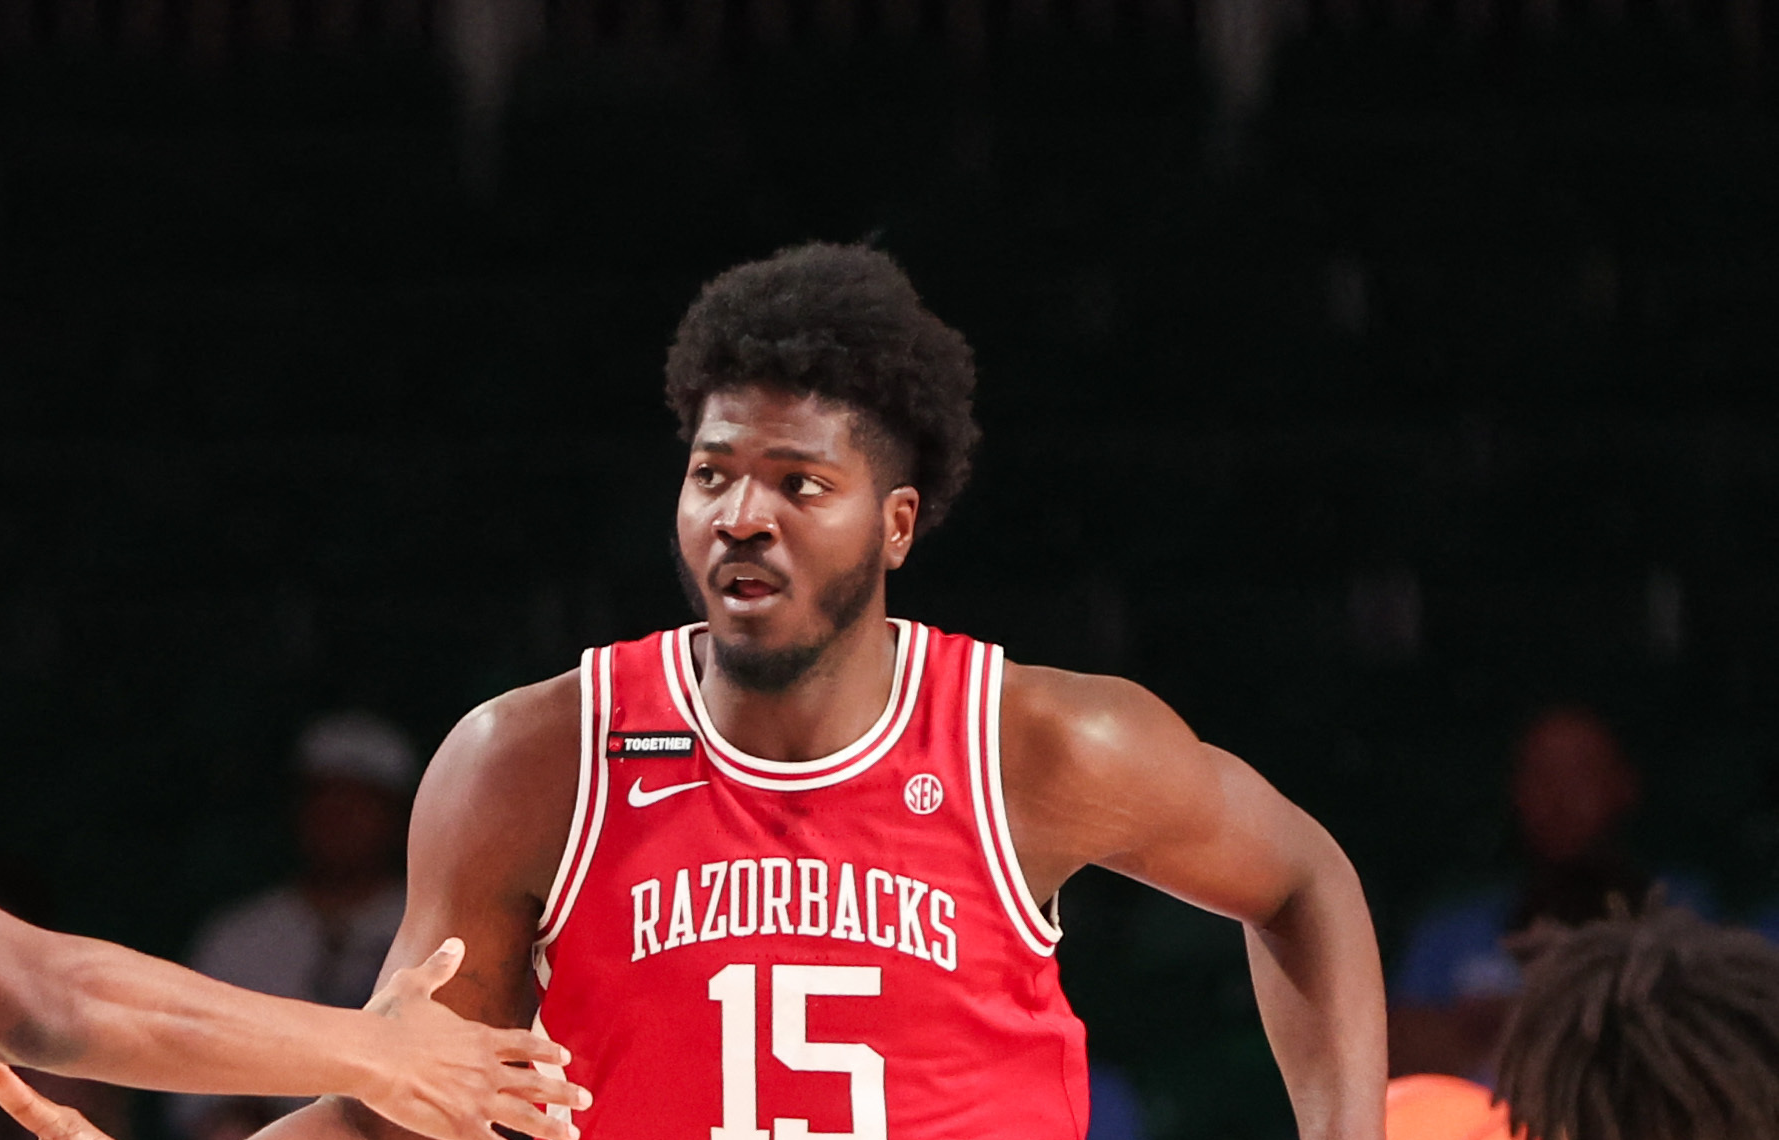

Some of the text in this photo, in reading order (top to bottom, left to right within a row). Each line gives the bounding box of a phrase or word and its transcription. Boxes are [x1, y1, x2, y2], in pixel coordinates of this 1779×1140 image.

[624, 736, 692, 752] TOGETHER
[908, 776, 940, 811] SEC
[630, 856, 958, 972] RAZORBACKS
